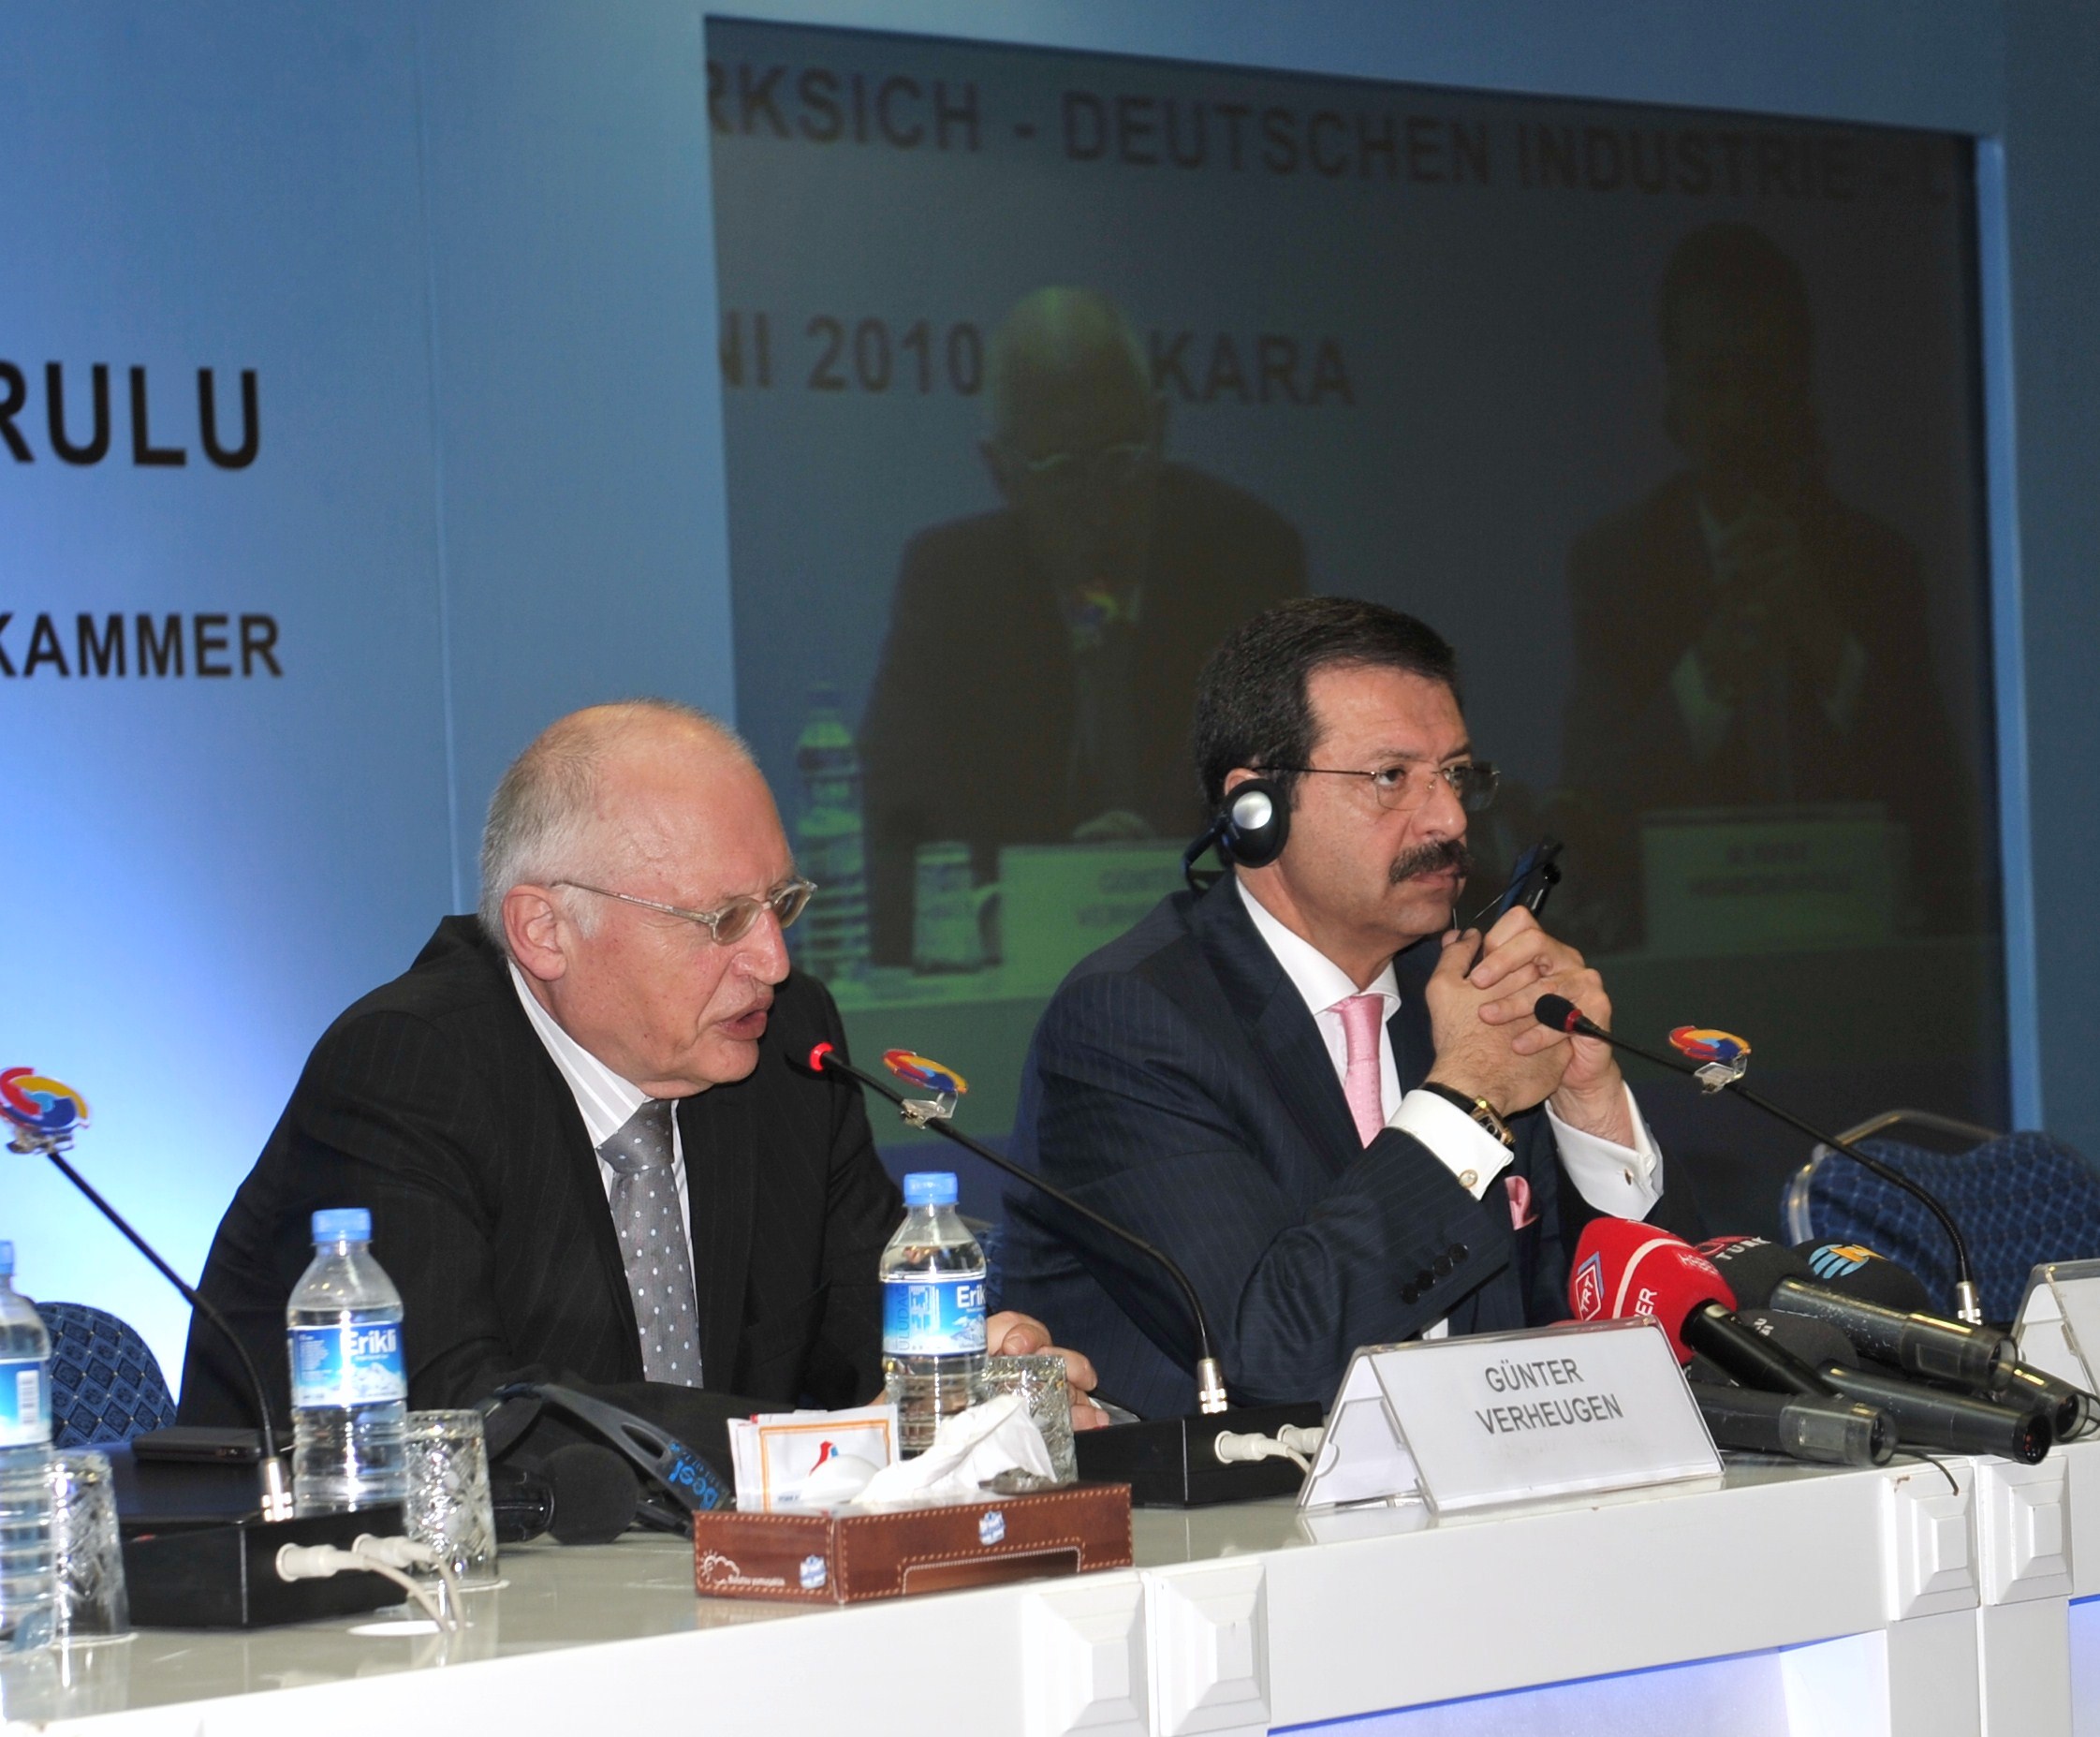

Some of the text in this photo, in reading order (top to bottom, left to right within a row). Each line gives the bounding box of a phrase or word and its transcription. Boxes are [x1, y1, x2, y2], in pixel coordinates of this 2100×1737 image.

[1061, 89, 1493, 185] DEUTSCHEN
[1515, 117, 1858, 203] INDUSTRIE
[804, 314, 986, 397] 2010
[1580, 1274, 1595, 1313] TRT
[1485, 1359, 1585, 1393] GÜNTER
[1475, 1392, 1624, 1435] VERHEUGEN
